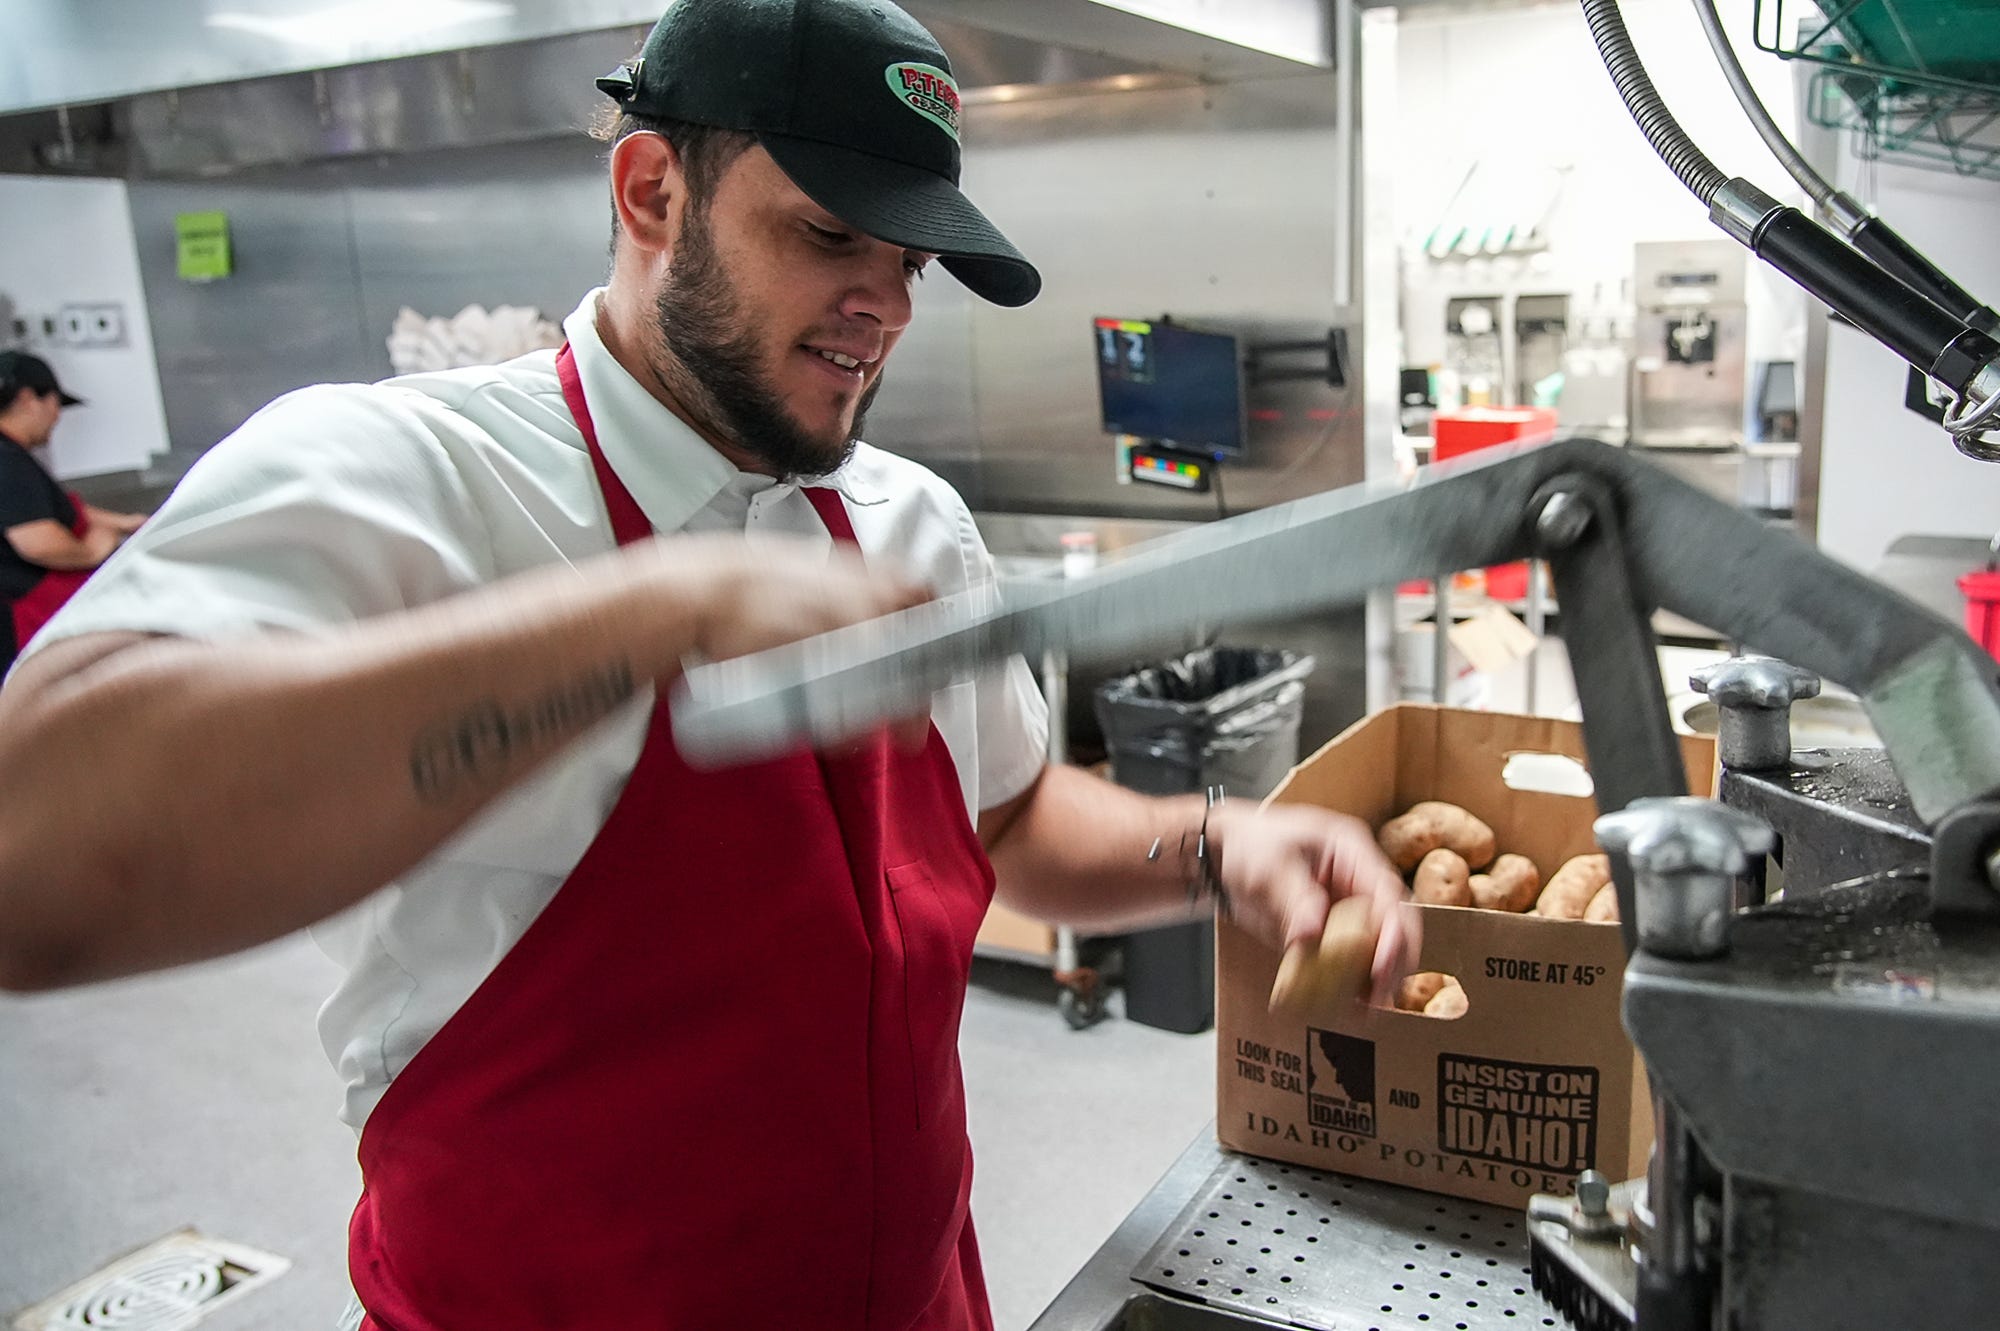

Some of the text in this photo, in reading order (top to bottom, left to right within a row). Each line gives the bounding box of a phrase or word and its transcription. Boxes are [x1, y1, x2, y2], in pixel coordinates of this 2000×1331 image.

[1485, 956, 1606, 986] STORE AT 45°
[1236, 1038, 1302, 1074] LOOK FOR
[1236, 1058, 1304, 1095] THIS SEAL
[1444, 1060, 1593, 1096] INSIST ON
[1389, 1088, 1420, 1110] AND
[1444, 1084, 1592, 1119] GENUINE
[1313, 1103, 1371, 1132] IDAHO
[1444, 1105, 1589, 1170] IDAHO!
